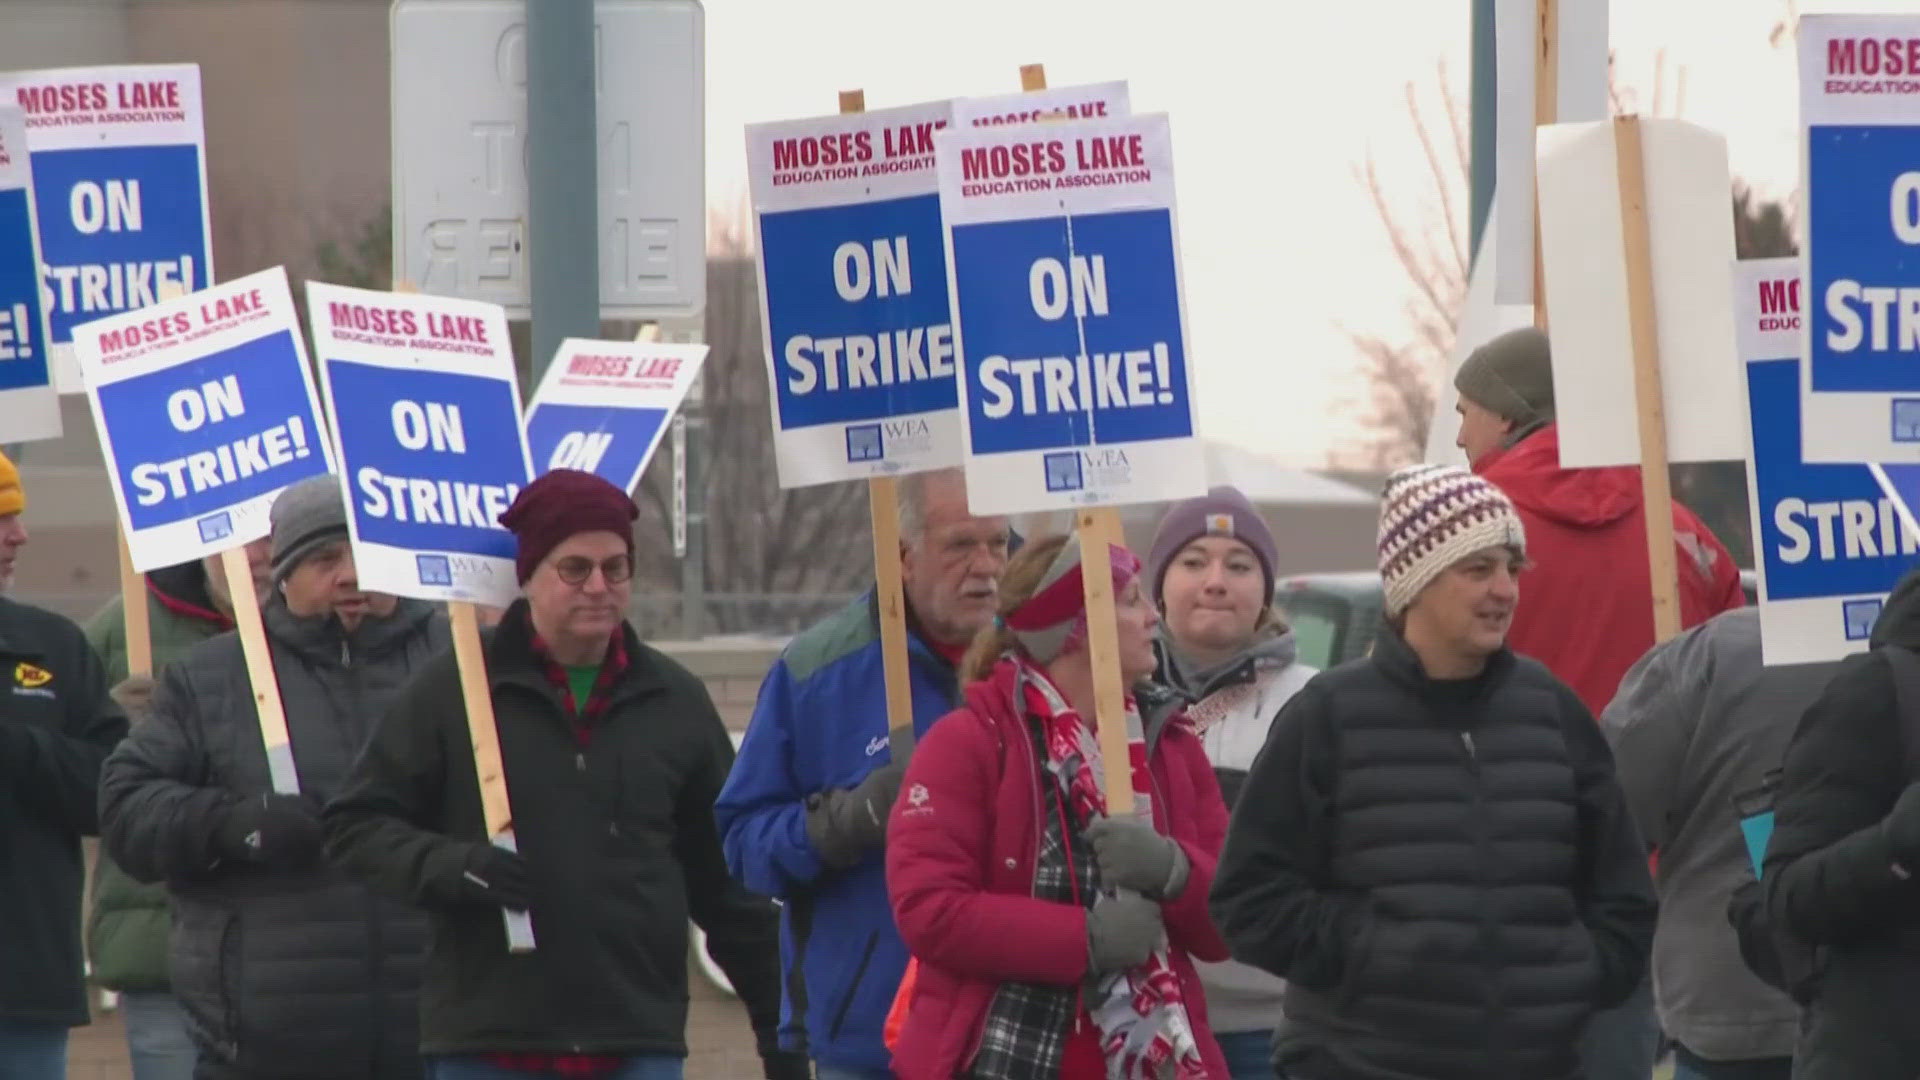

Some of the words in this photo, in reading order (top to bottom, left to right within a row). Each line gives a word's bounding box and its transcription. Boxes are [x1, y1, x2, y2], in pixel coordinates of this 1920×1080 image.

[16, 84, 108, 113] MOSES
[117, 80, 179, 109] LAKE
[98, 111, 185, 124] ASSOCIATION
[773, 130, 873, 171] MOSES
[961, 140, 1066, 181] MOSES
[1076, 134, 1145, 171] LAKE
[773, 166, 858, 187] EDUCATION
[962, 178, 1052, 198] EDUCATION
[1055, 170, 1151, 189] ASSOCIATION
[70, 179, 142, 234] ON
[833, 235, 912, 302] ON
[1029, 254, 1110, 320] ON
[98, 311, 191, 354] MOSES
[200, 289, 264, 325] LAKE
[329, 301, 418, 336] MOSES
[427, 311, 488, 344] LAKE
[634, 357, 684, 379] LAKE
[978, 341, 1174, 419] STRIKE!
[166, 374, 246, 433] ON
[391, 398, 466, 454] ON
[130, 415, 311, 507] STRIKE!
[548, 430, 614, 474] ON
